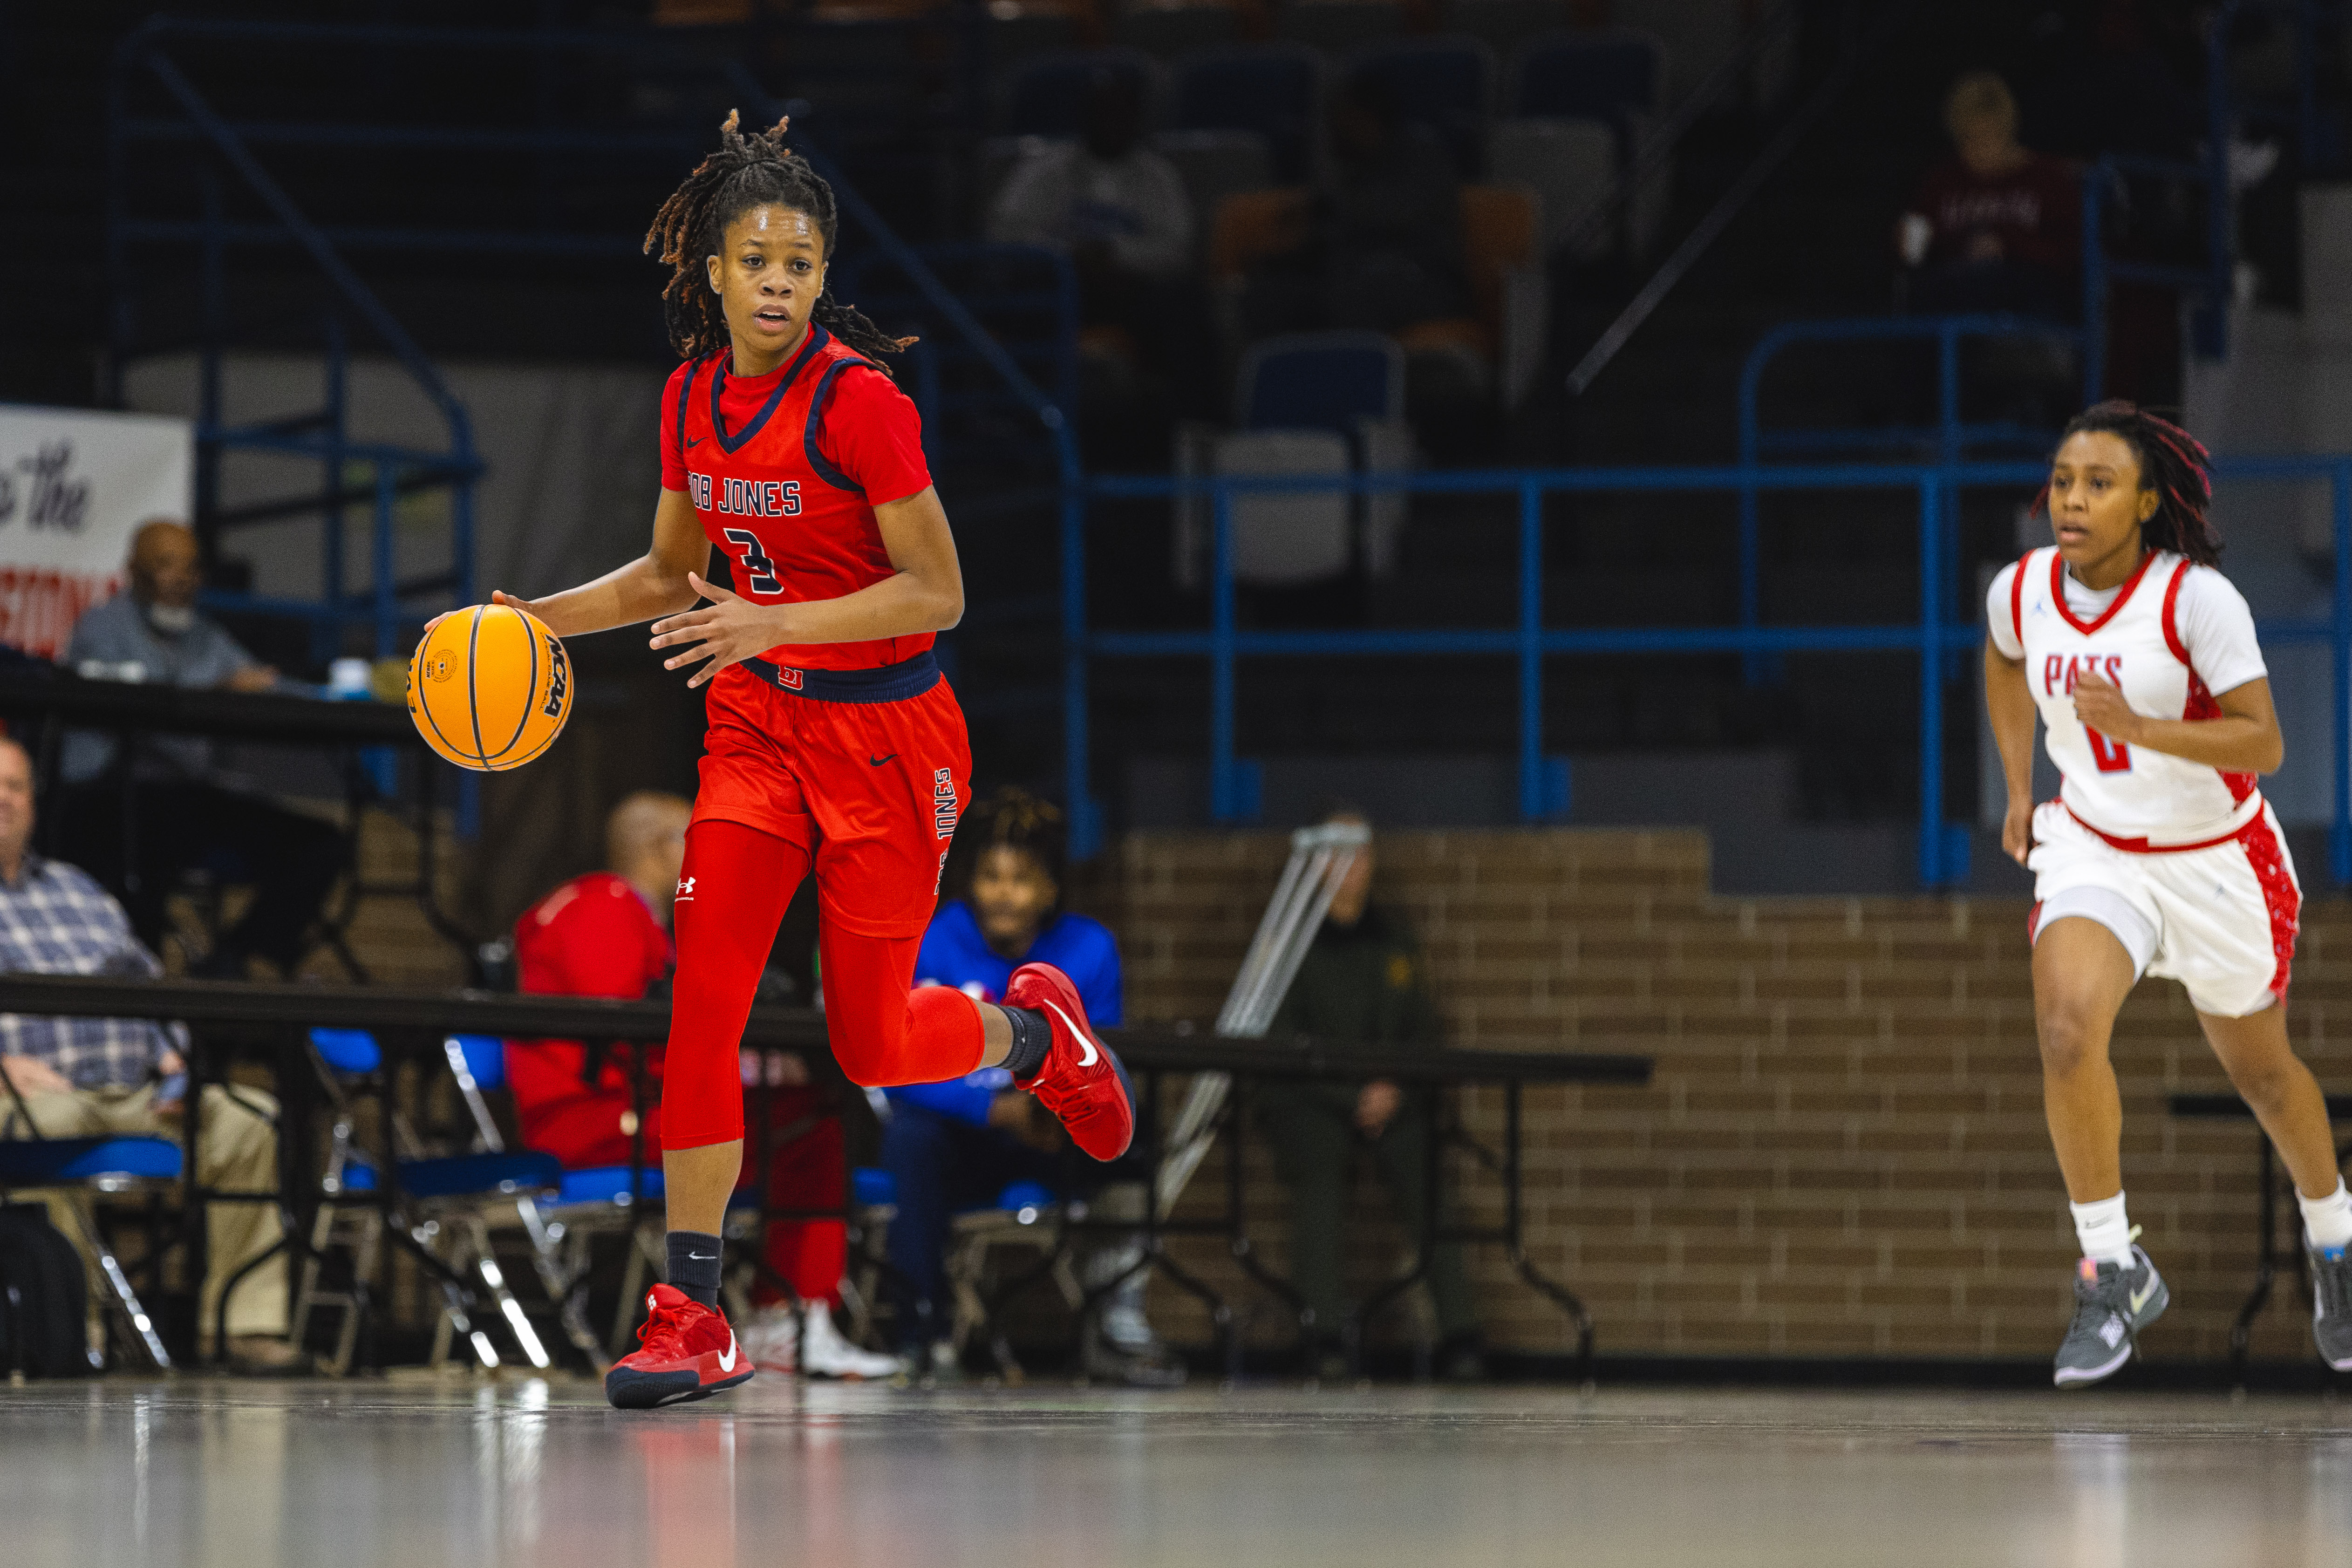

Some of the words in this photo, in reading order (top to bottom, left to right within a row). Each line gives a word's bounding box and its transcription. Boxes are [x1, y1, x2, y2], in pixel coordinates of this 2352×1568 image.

[688, 470, 712, 511] OB
[718, 477, 802, 517] JONES
[723, 528, 784, 594] 3
[539, 690, 548, 711] BALL
[544, 634, 566, 718] NCAA
